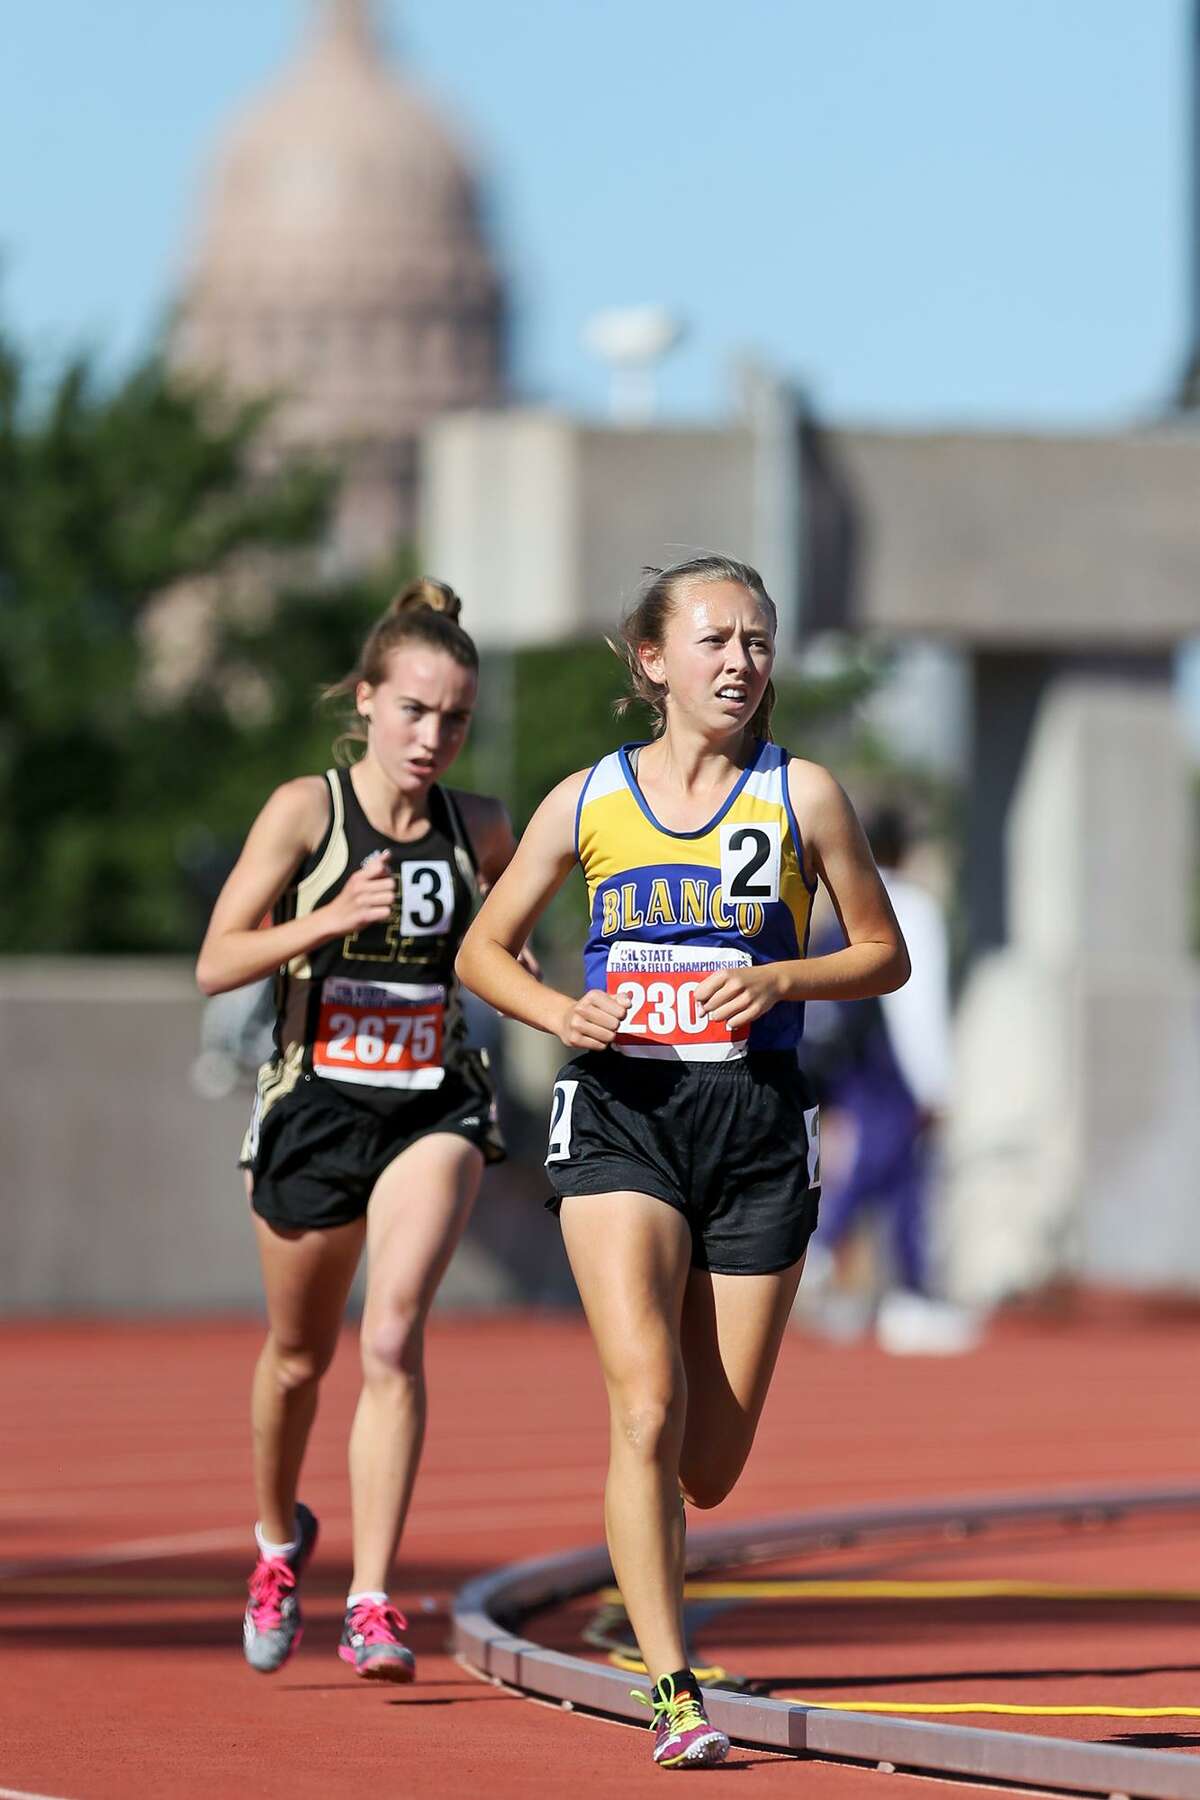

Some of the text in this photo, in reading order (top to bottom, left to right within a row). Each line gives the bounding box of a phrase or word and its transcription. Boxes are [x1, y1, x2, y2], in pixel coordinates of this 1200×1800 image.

[728, 828, 771, 897] 2
[410, 868, 444, 928] 3
[602, 879, 764, 937] BLANCO
[611, 962, 639, 973] TRACK
[648, 962, 671, 973] FIELD
[672, 960, 749, 973] CHAMPIONSHIPS
[640, 949, 674, 962] STATE
[616, 981, 737, 1035] 230
[326, 1013, 437, 1064] 2675
